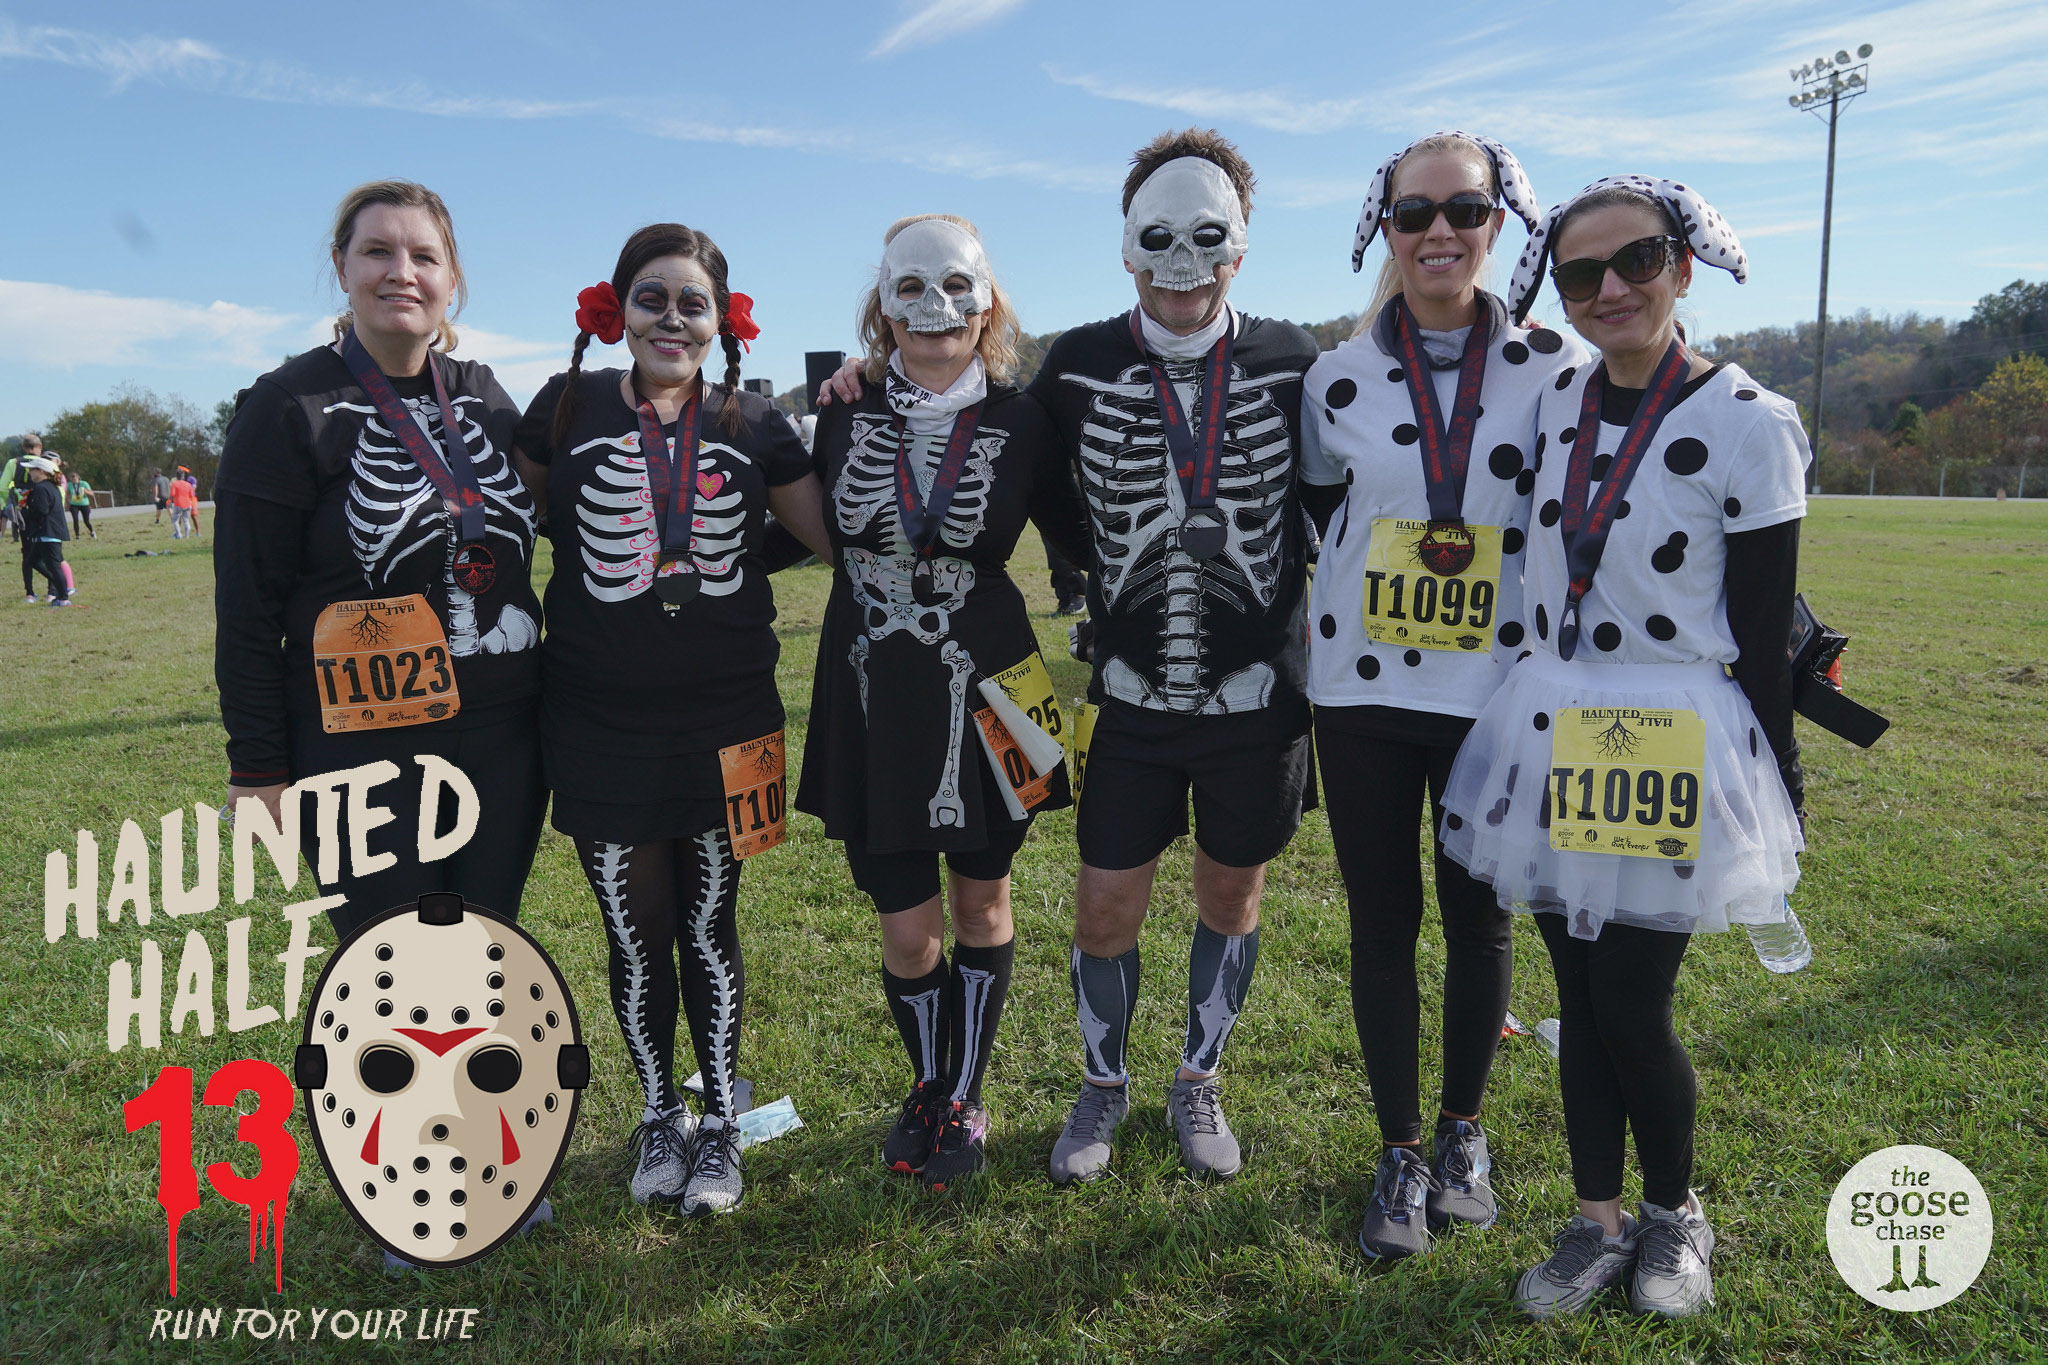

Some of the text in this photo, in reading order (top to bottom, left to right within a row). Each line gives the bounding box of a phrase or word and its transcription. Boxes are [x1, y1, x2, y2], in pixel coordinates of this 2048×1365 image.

[336, 602, 386, 612] HAUNTED
[1365, 570, 1495, 629] T1099
[385, 603, 415, 616] HALF
[316, 645, 452, 706] T1023
[1013, 665, 1032, 682] HALF
[1581, 709, 1640, 718] HAUNTED
[1637, 718, 1673, 727] HALF
[740, 735, 776, 753] HAUNTED
[1552, 767, 1698, 829] T1099
